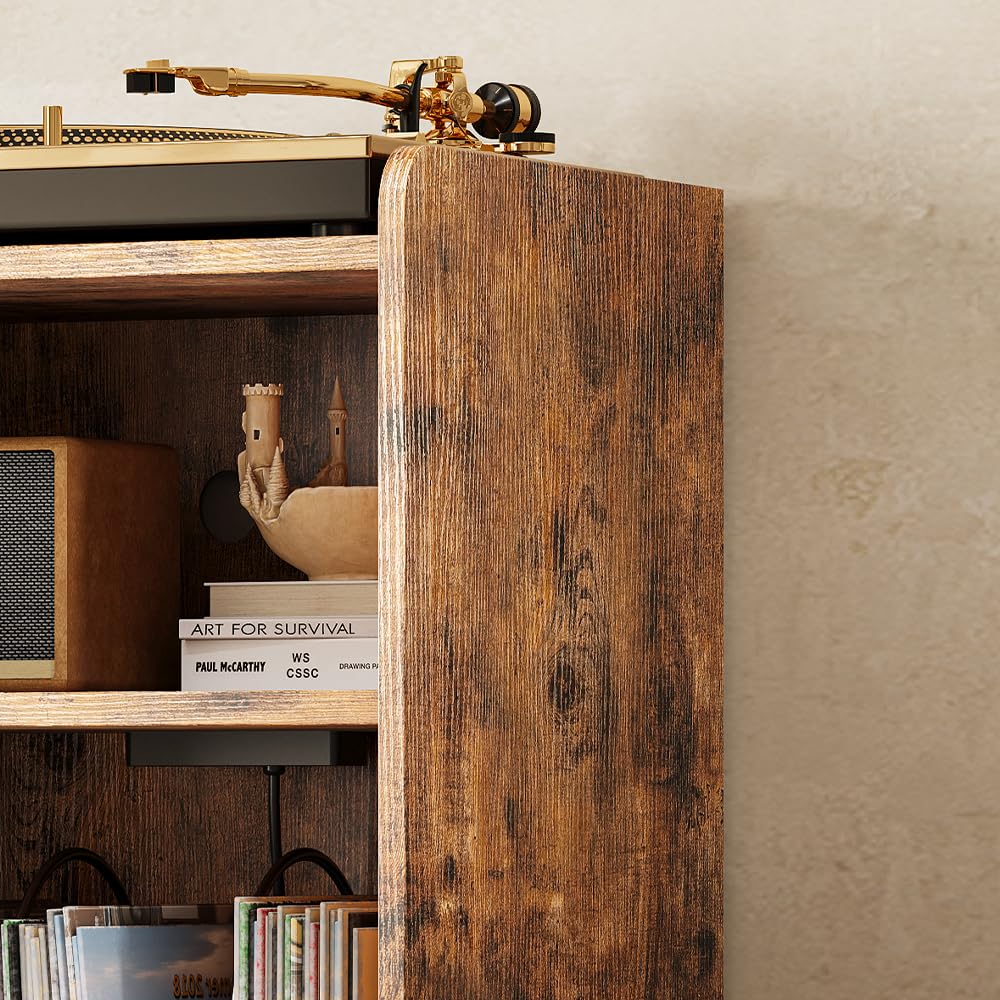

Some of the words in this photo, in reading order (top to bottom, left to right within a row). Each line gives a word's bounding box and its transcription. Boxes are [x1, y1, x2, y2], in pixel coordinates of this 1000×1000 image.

[191, 623, 224, 635] ART
[232, 623, 267, 635] FOR
[274, 622, 356, 635] SURVIVAL
[292, 653, 310, 663] WS
[195, 662, 218, 673] PAUL
[220, 661, 266, 673] McCARTHY
[286, 668, 319, 679] CSSC
